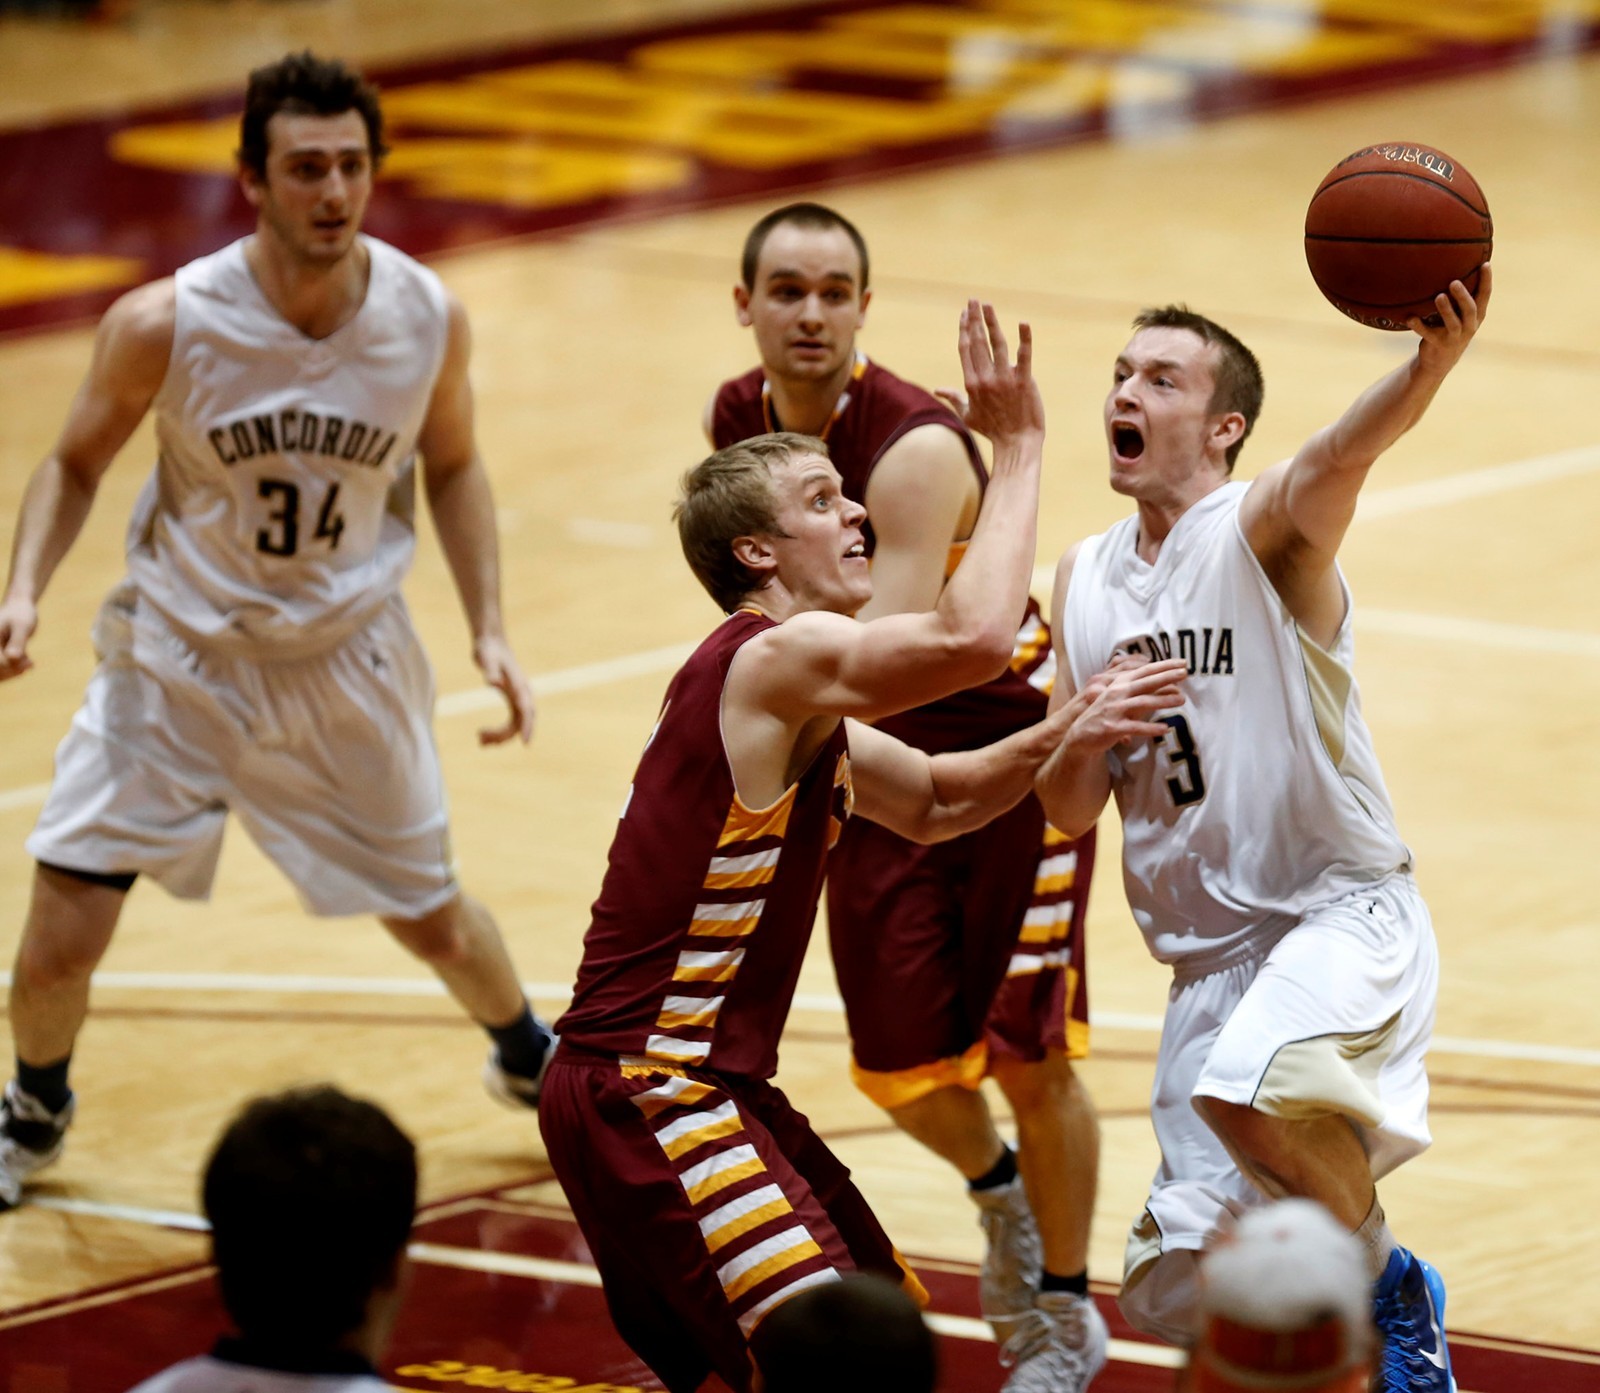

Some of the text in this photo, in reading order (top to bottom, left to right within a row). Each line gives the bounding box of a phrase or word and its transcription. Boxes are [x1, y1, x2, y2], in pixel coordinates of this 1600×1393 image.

[208, 409, 397, 467] CONCORDIA
[257, 477, 345, 557] 34
[1153, 714, 1205, 806] 3
